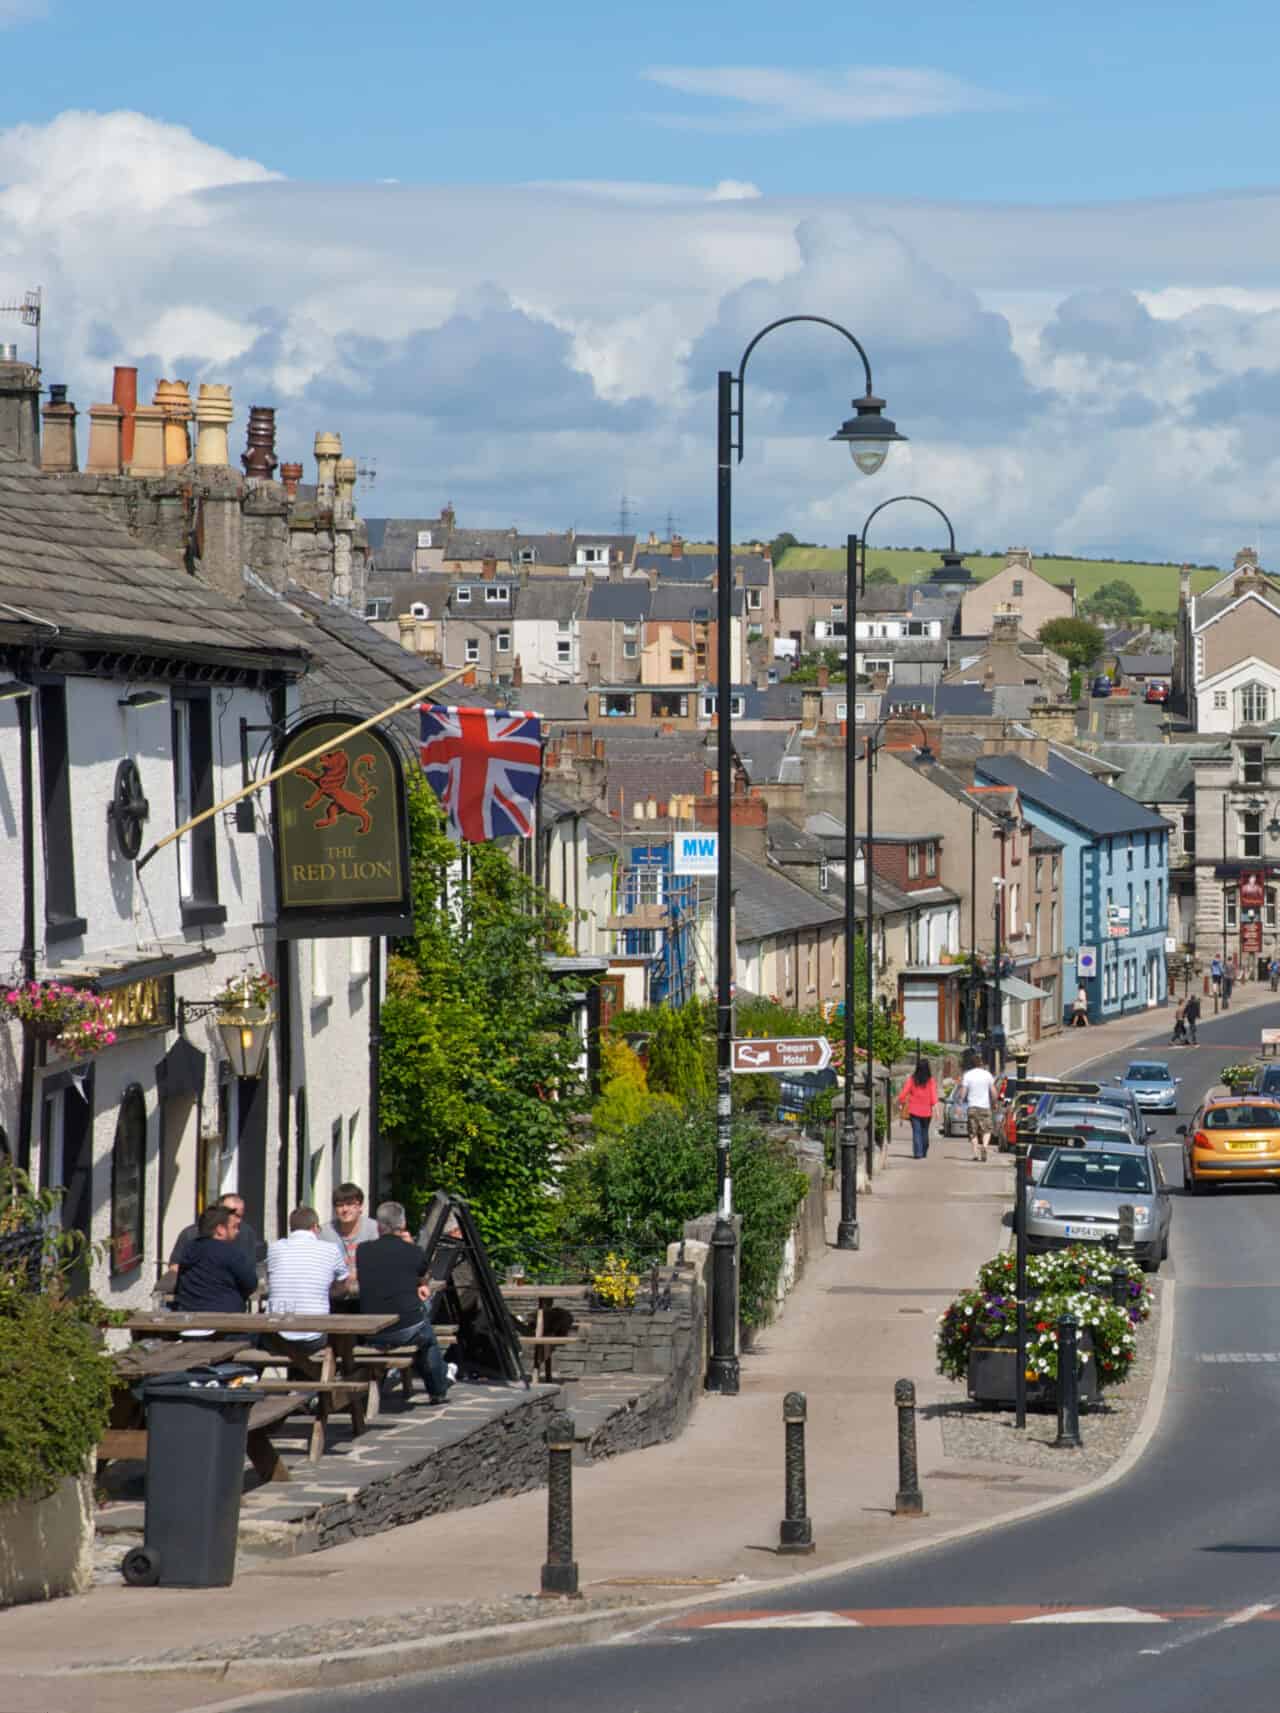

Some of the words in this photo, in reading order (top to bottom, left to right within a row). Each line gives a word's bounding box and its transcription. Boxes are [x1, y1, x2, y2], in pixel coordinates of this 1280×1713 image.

[328, 847, 354, 857] THE
[682, 839, 715, 857] MW
[292, 864, 336, 880] RED
[341, 861, 392, 880] LION
